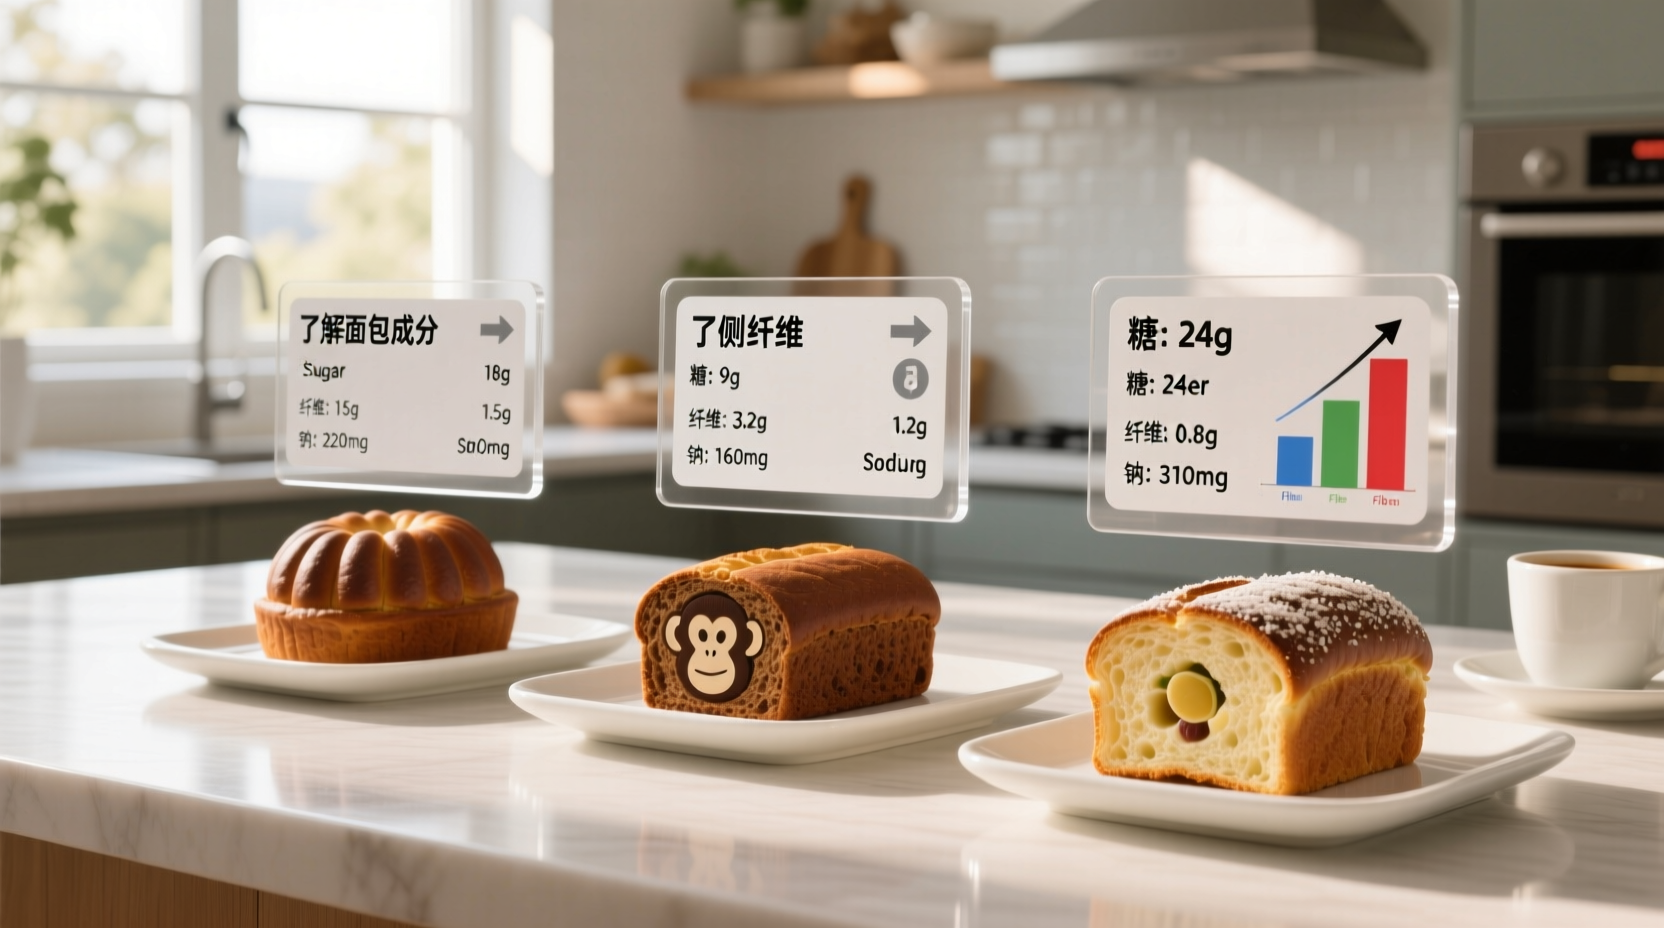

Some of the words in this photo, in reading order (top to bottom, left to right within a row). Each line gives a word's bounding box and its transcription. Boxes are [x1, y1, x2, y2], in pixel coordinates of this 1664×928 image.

[301, 312, 438, 346] 了解面包成分
[692, 314, 804, 349] 了侧纤维
[1127, 315, 1168, 351] 糖:
[1178, 320, 1232, 356] 24g
[302, 360, 346, 383] Sugar
[485, 364, 511, 386] 18g
[689, 363, 713, 387] 糖:
[719, 366, 740, 390] 9g
[1126, 369, 1155, 396] 糖:
[1162, 373, 1210, 396] 24er
[335, 399, 359, 421] 15g
[482, 404, 511, 425] 1.5g
[688, 407, 727, 430] 纤维:
[732, 410, 767, 434] 3.2g
[892, 415, 927, 440] 1.2g
[1124, 419, 1168, 444] 纤维:
[1175, 423, 1218, 450] 0.8g
[322, 432, 368, 454] 220mg
[686, 444, 709, 465] 钠:
[715, 447, 768, 471] 160mg
[1123, 461, 1151, 486] 钠:
[1159, 464, 1228, 493] 310mg
